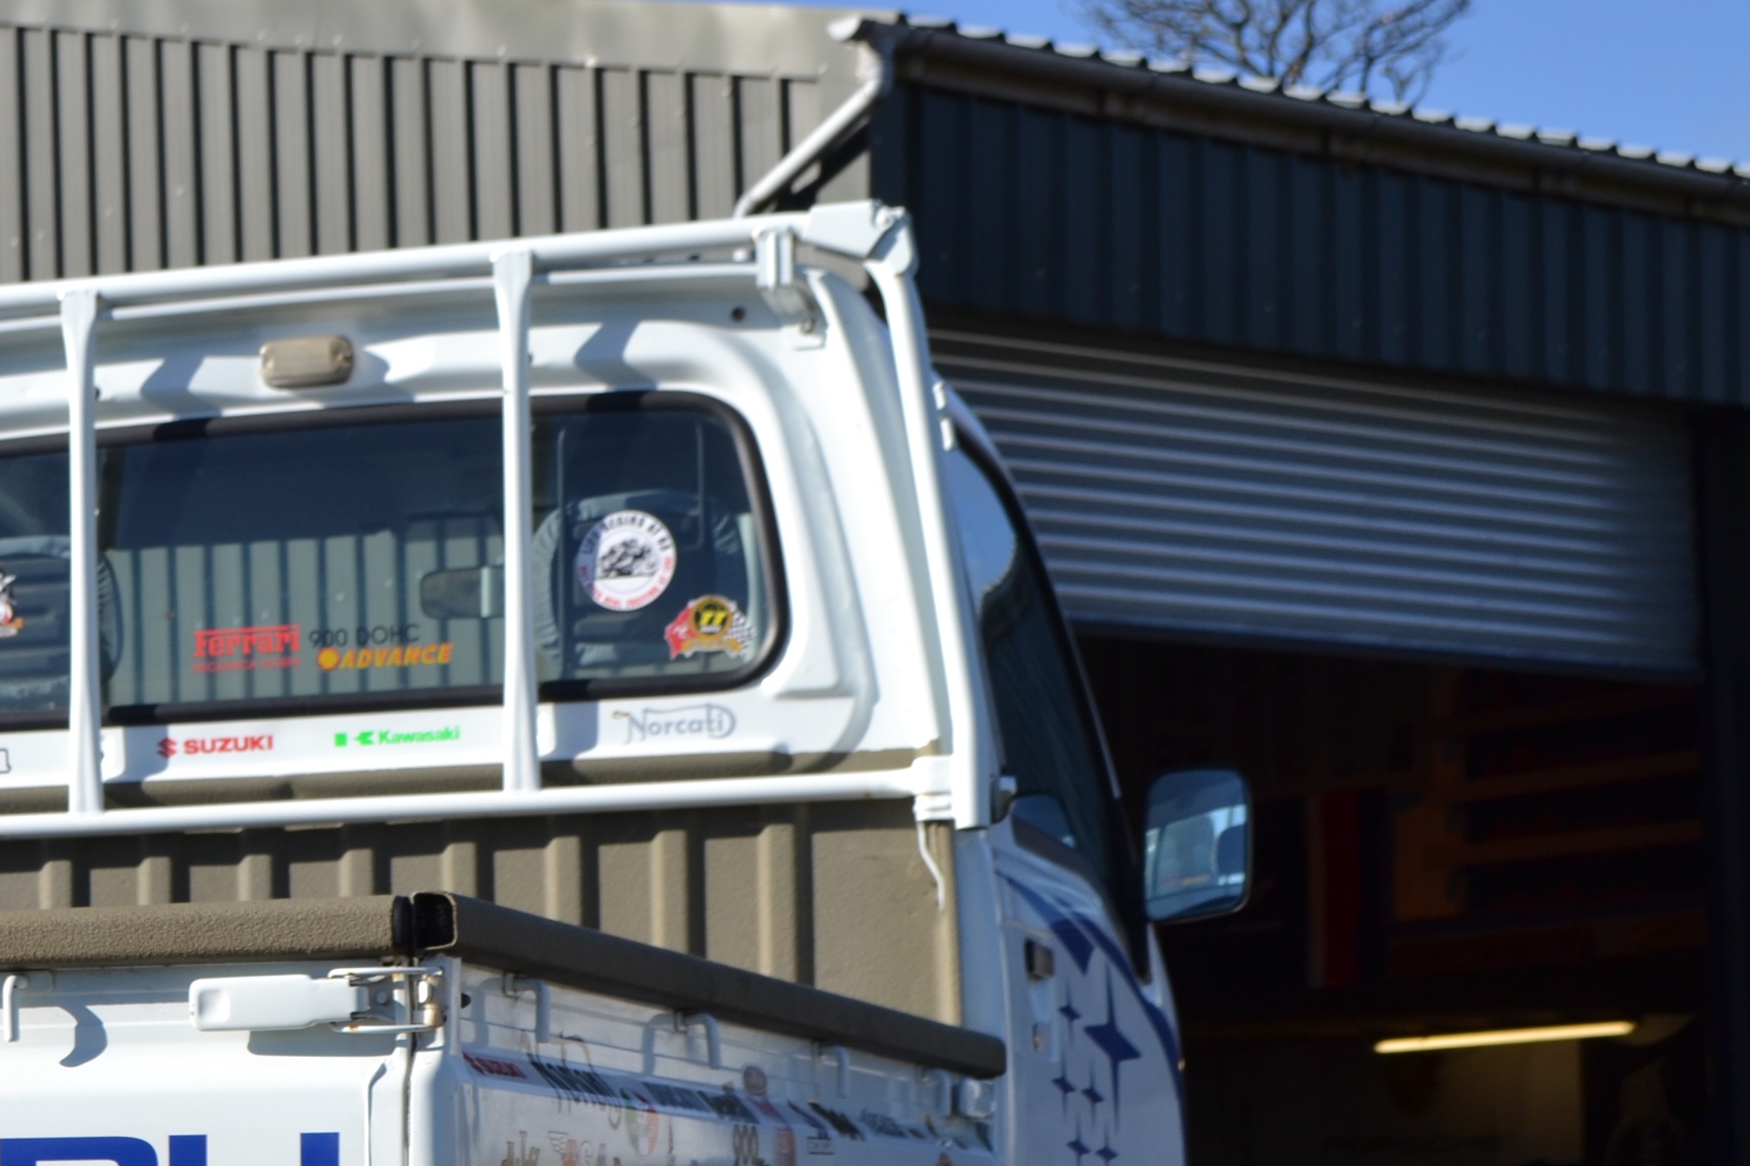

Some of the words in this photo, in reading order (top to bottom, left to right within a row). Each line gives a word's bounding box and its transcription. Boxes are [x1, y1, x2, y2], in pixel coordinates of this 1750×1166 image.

[192, 624, 301, 659] Ferrari
[308, 628, 348, 648] 900
[356, 623, 420, 646] DOHC
[340, 642, 454, 669] ADVANCE
[183, 735, 274, 755] SUZUKI
[378, 726, 460, 745] Kawasaki
